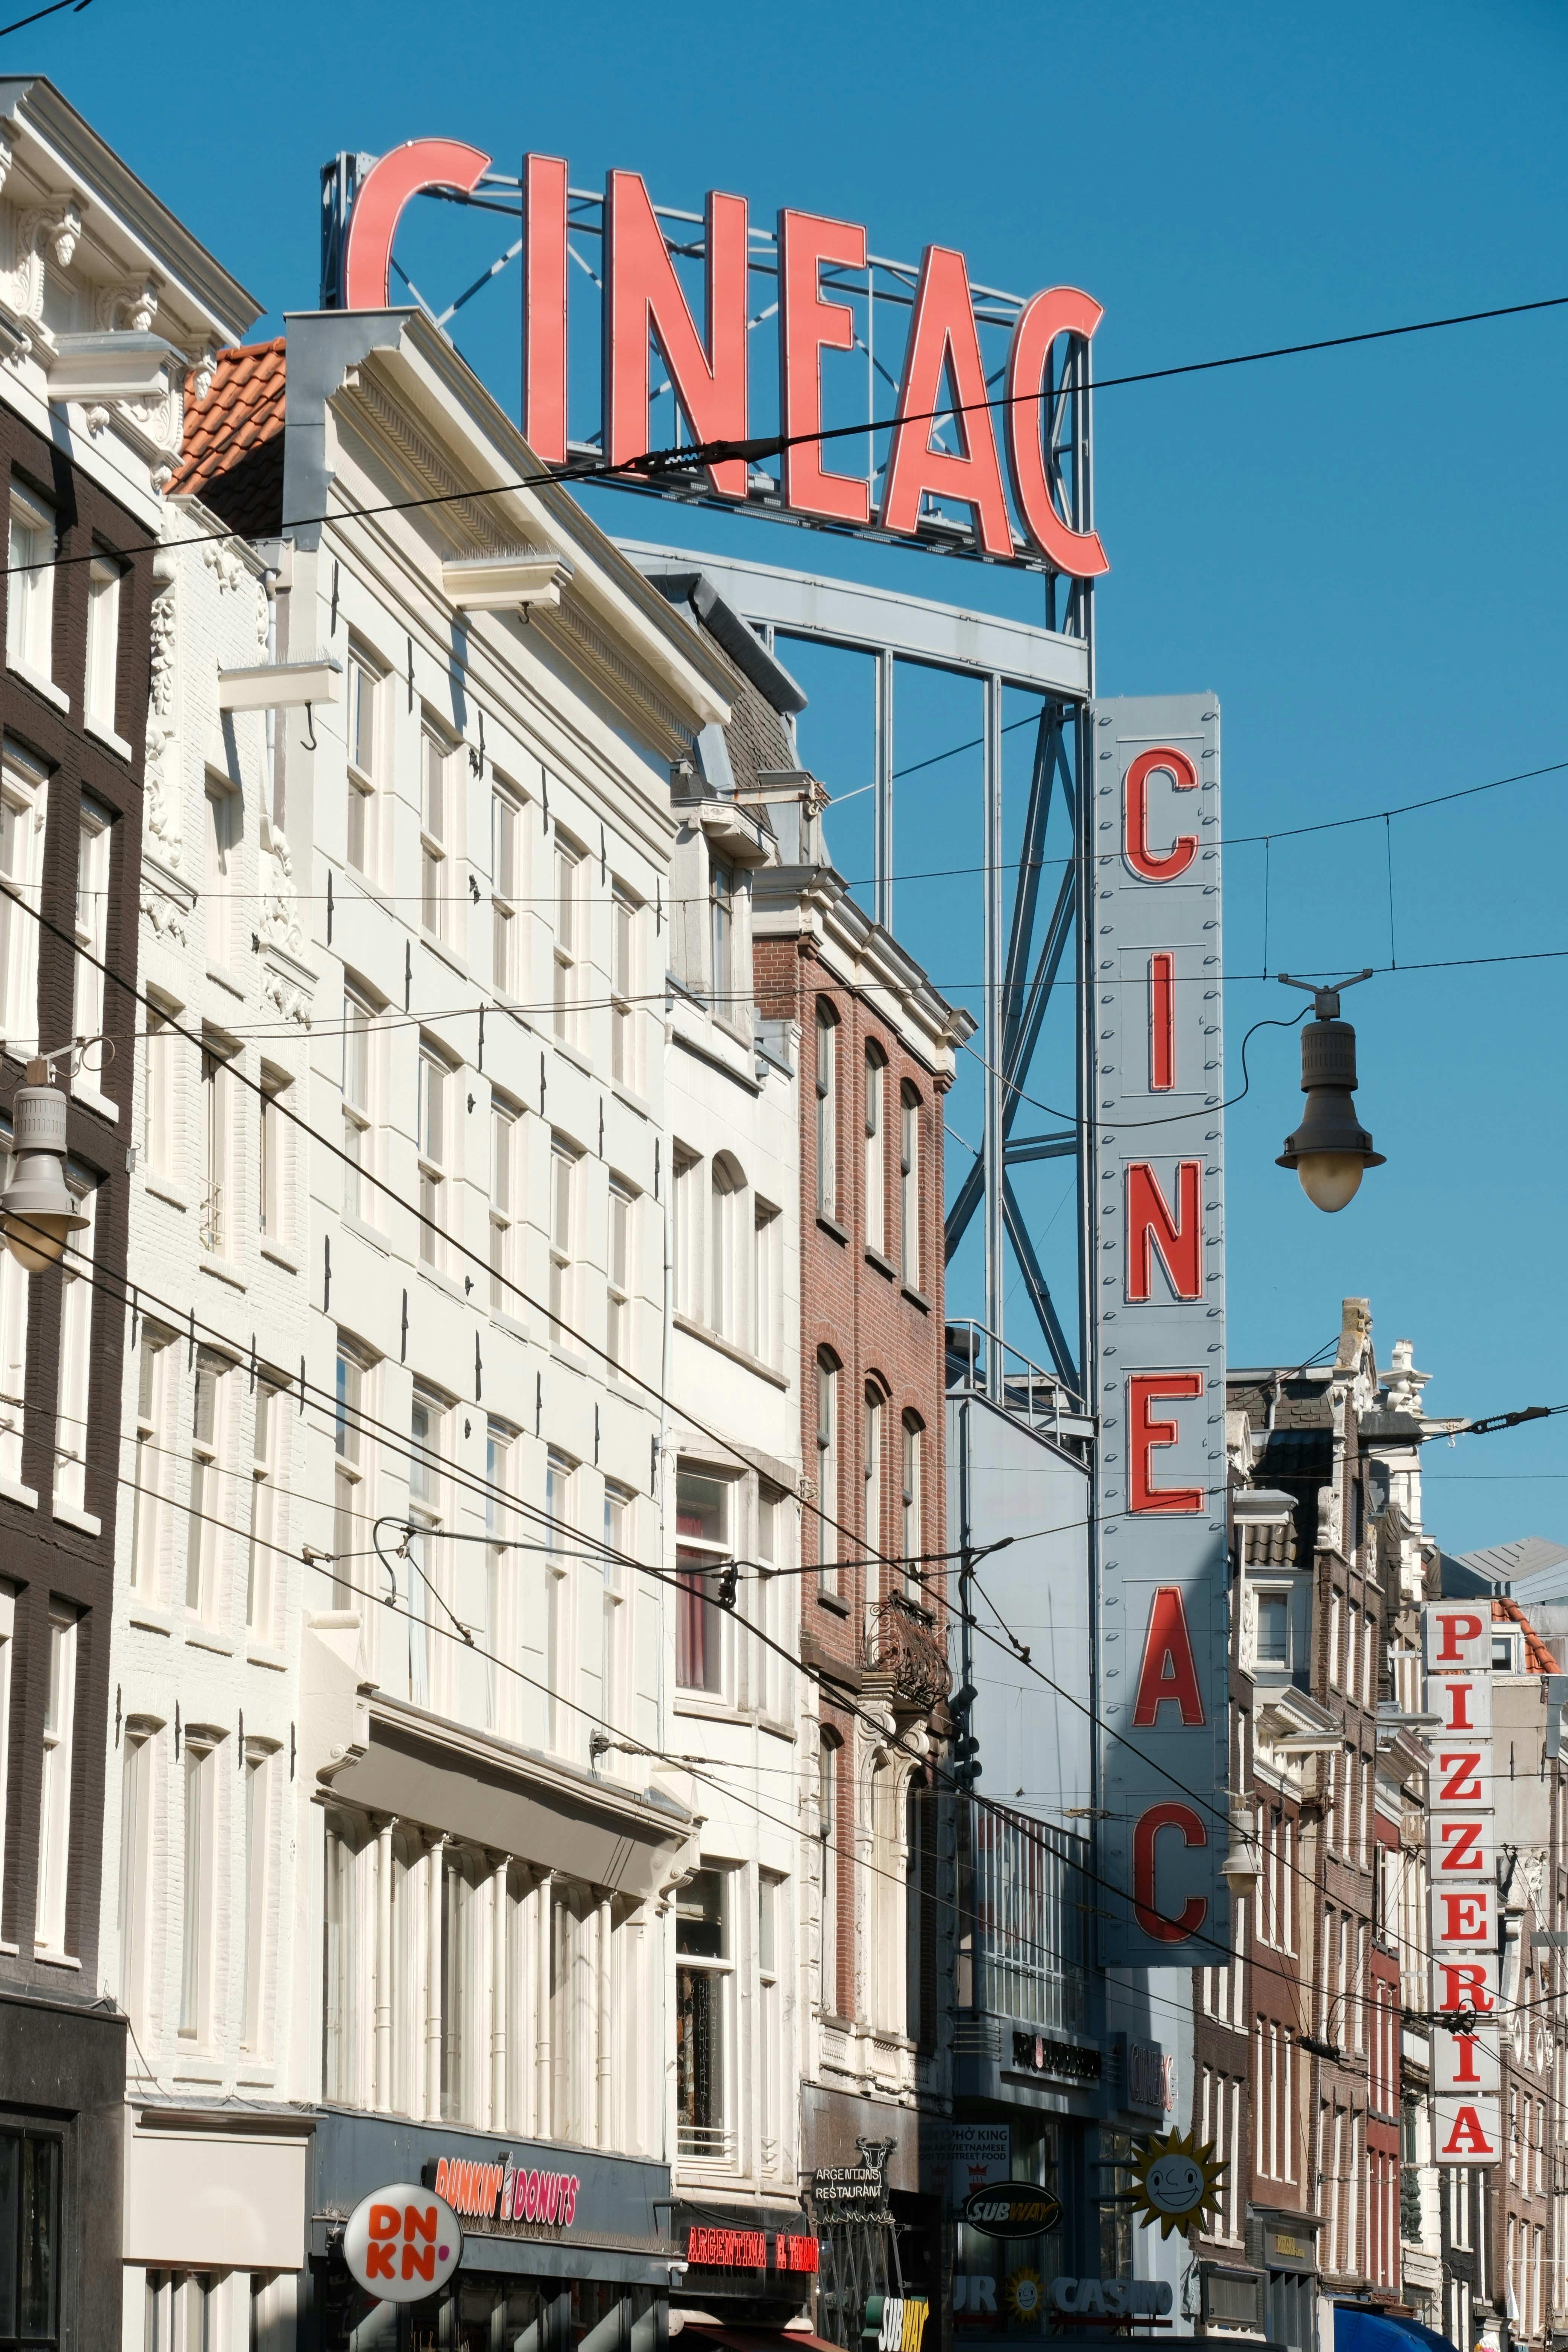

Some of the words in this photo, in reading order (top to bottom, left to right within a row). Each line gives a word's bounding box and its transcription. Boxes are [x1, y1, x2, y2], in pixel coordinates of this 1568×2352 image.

[340, 137, 1112, 579] CINEAC
[1122, 745, 1207, 1943] CINEAC
[1436, 1614, 1494, 2153] PIZZERIA
[978, 2130, 1007, 2141] KING
[435, 2157, 504, 2218] DUNKIN'
[513, 2168, 577, 2228] DONUTS
[816, 2185, 882, 2199] RESTAURANT
[966, 2202, 1060, 2222] SUBWAY
[369, 2205, 438, 2243] DN
[688, 2226, 767, 2268] ARGENTINA
[777, 2234, 787, 2269] EL
[1051, 2277, 1173, 2315] CASINO
[878, 2296, 929, 2352] SUBWAY
